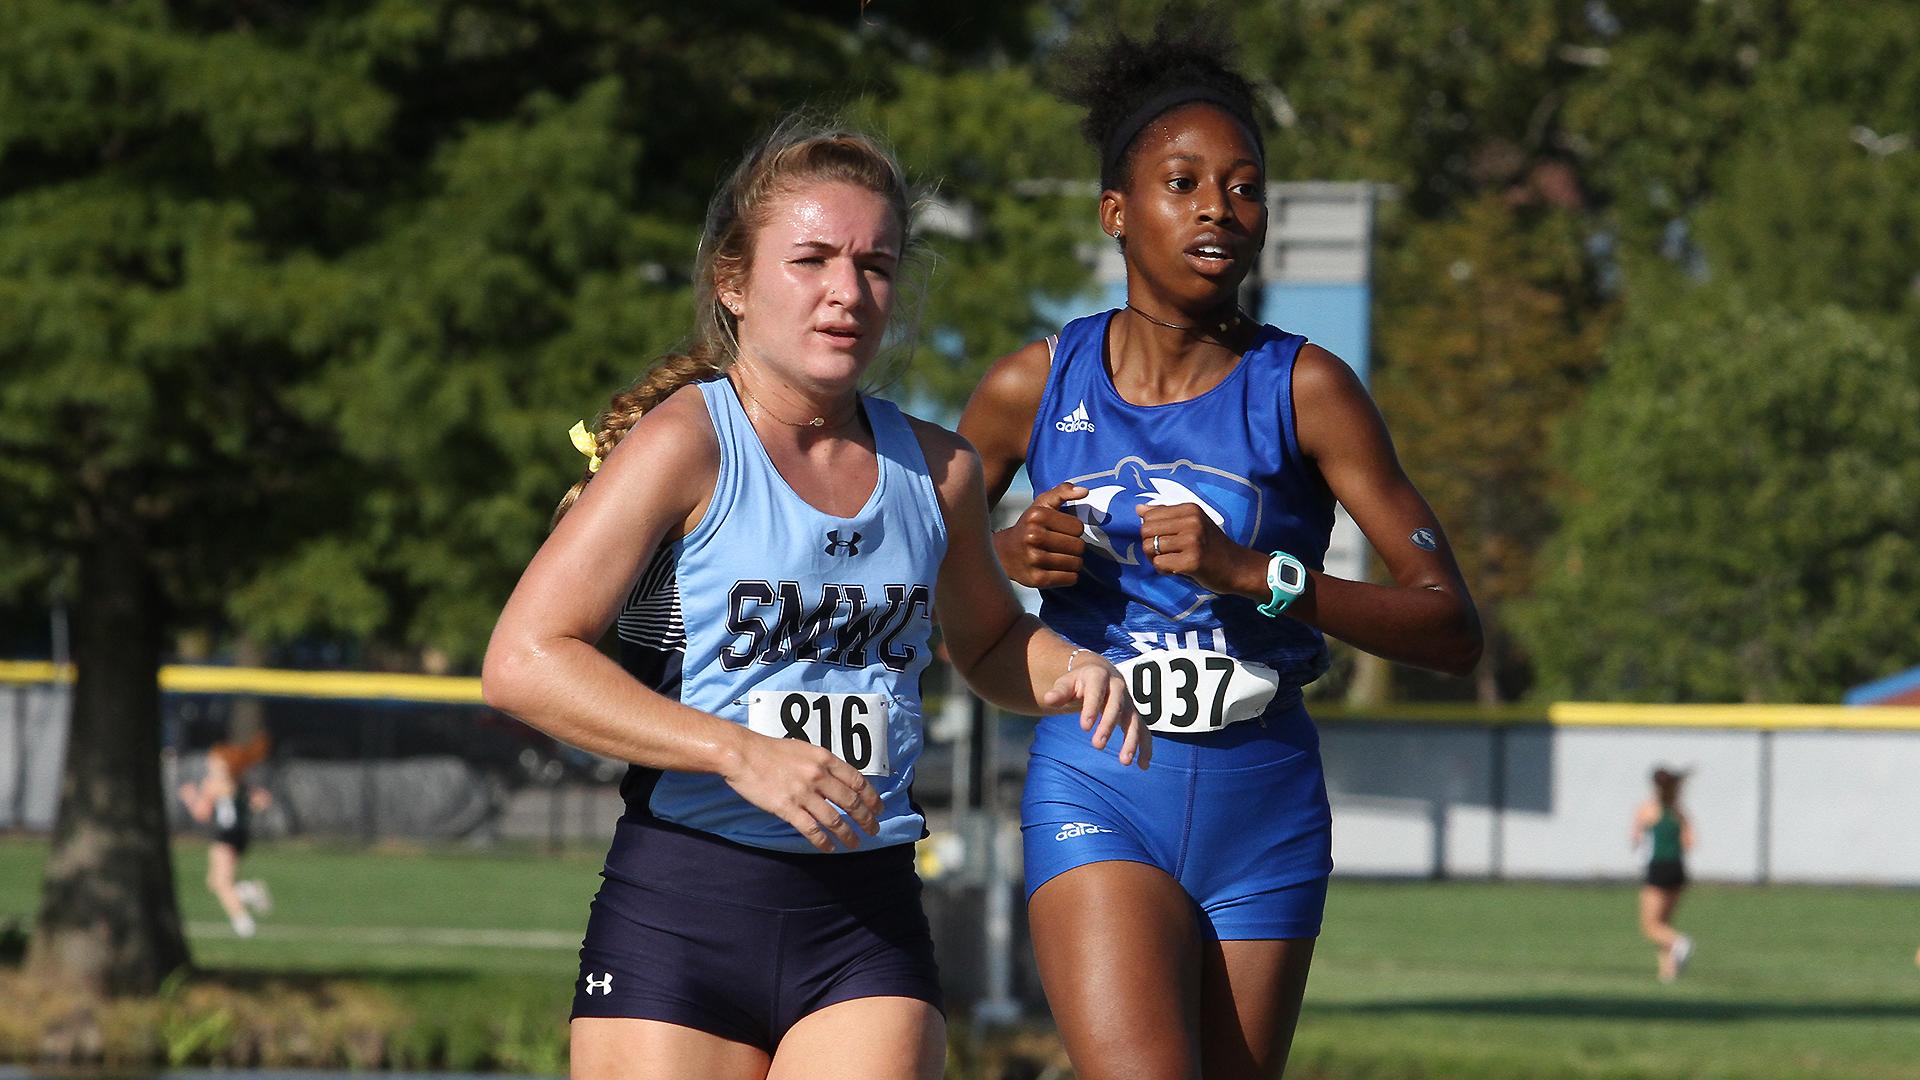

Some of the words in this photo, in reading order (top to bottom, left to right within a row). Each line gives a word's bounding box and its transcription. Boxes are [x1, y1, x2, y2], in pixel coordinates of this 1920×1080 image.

[719, 579, 929, 673] SMWC
[1131, 656, 1235, 728] 937
[779, 692, 873, 771] 816
[1054, 825, 1113, 842] adid
